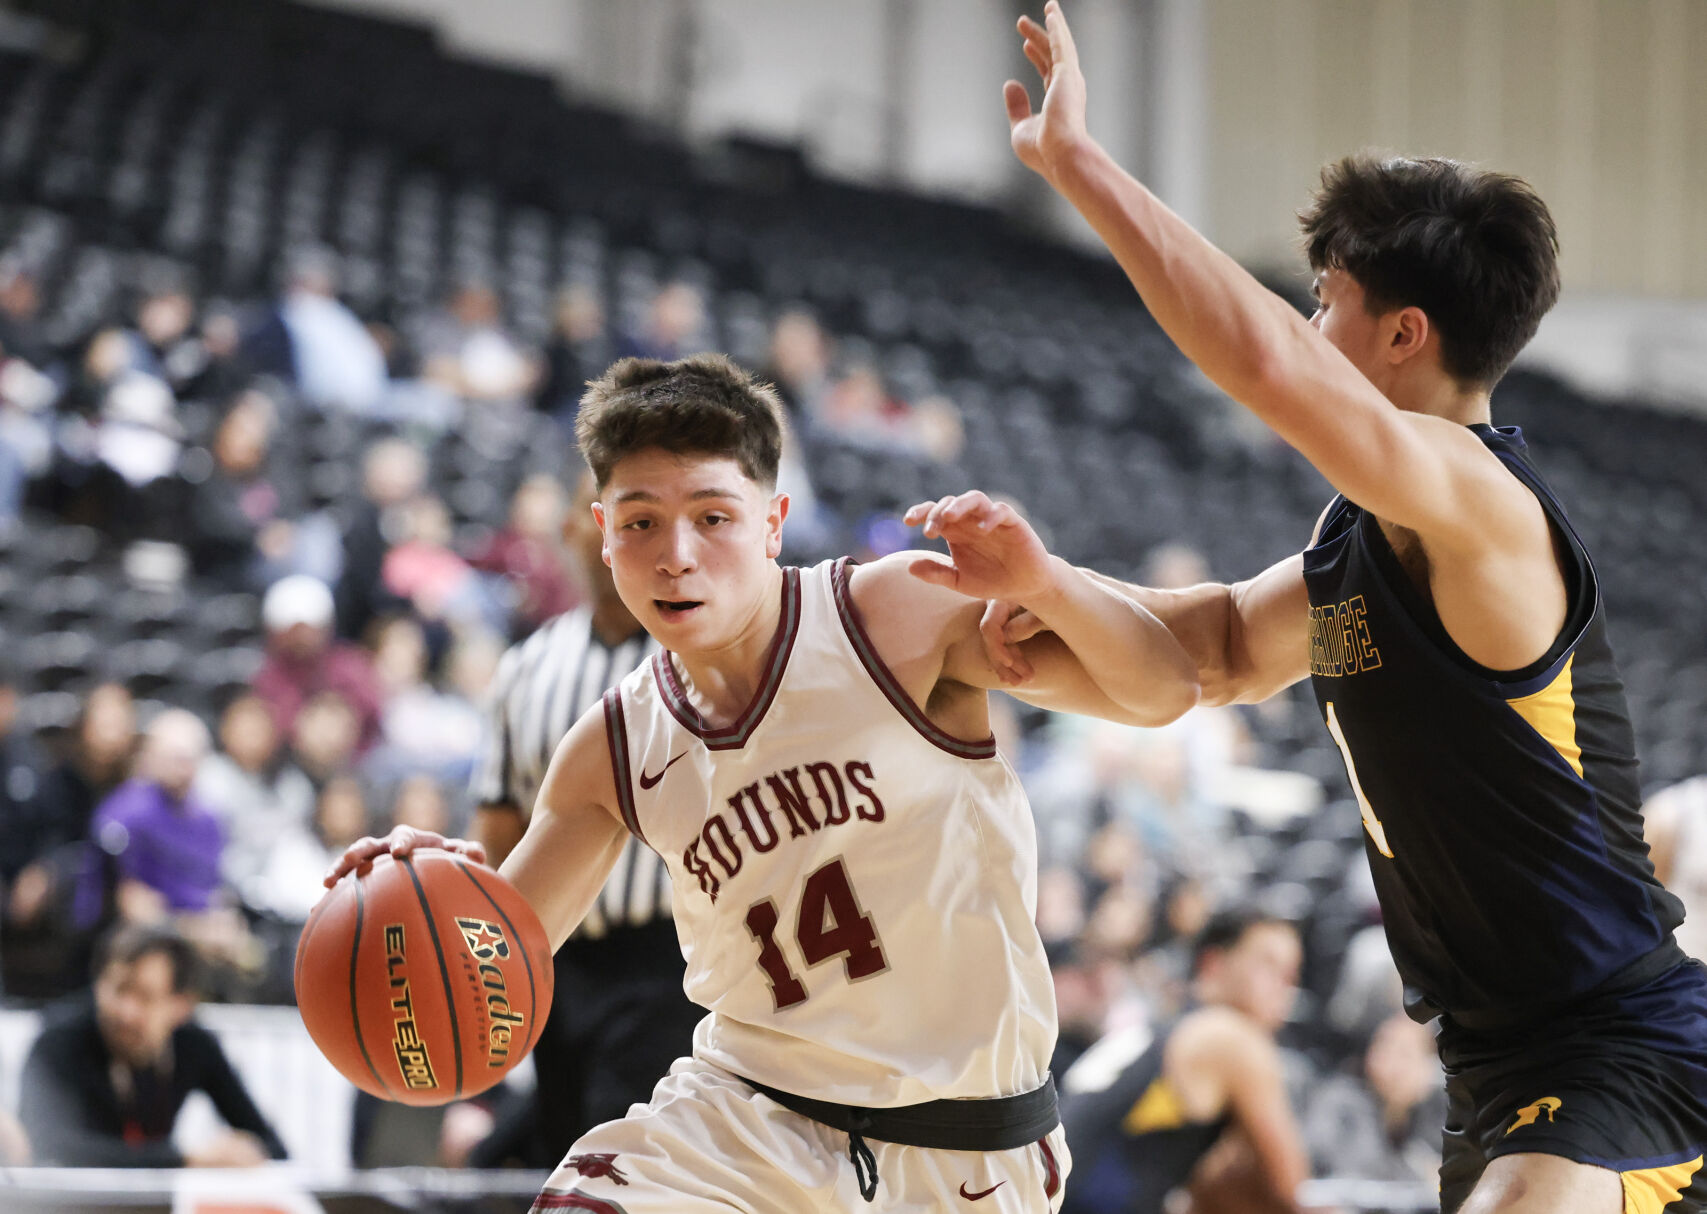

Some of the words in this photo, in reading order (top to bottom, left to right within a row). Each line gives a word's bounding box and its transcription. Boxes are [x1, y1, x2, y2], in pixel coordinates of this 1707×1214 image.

[683, 760, 886, 906] HOUNDS
[1326, 701, 1395, 859] 1
[383, 923, 421, 1049] ELITE
[454, 917, 524, 1068] Baden
[743, 853, 891, 1014] 14
[395, 1040, 439, 1089] PRO
